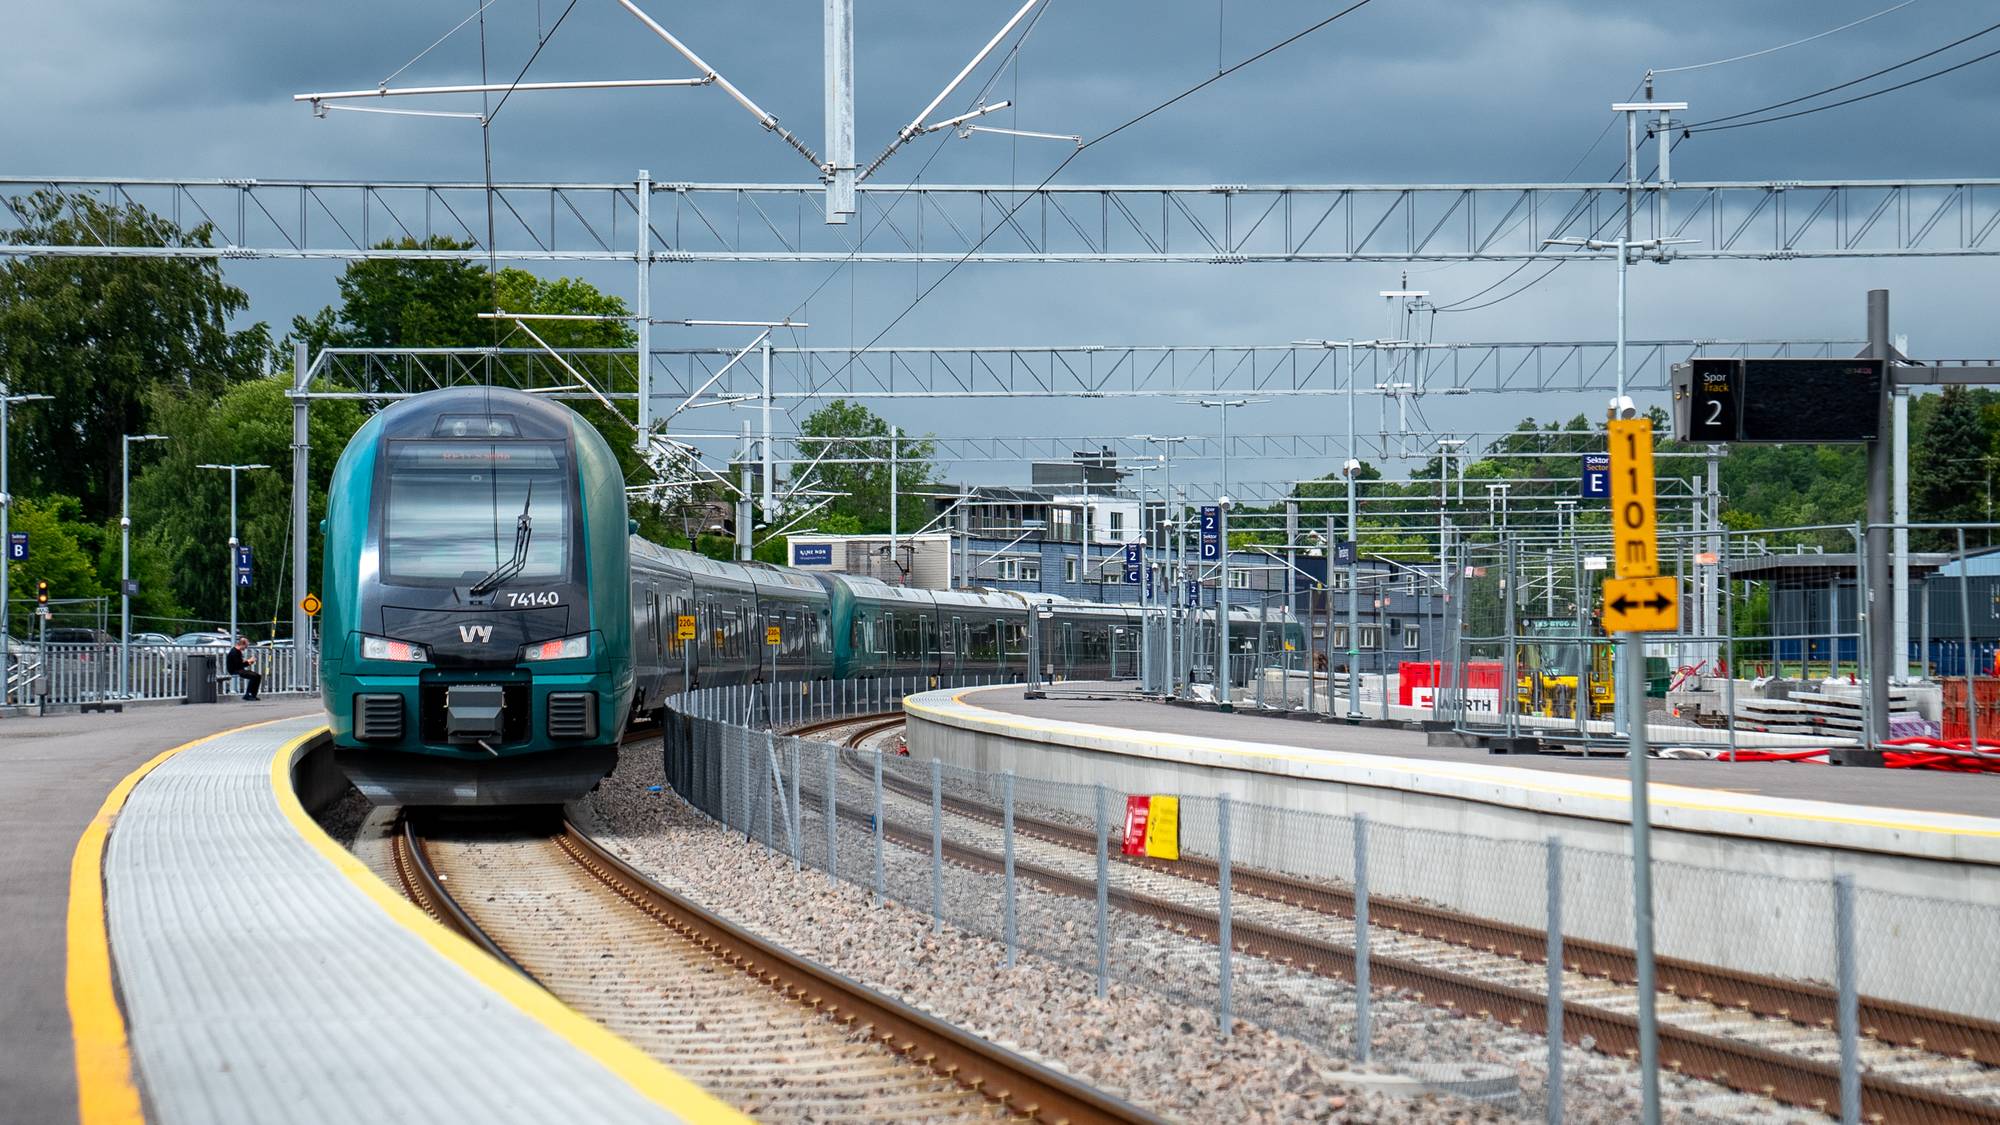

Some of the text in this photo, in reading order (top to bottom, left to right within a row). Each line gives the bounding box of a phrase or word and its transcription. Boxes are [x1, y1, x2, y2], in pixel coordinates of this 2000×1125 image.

[1703, 372, 1727, 383] Spor
[1703, 383, 1729, 392] Track
[1705, 400, 1722, 425] 2
[1586, 456, 1609, 464] Sektor
[1591, 473, 1604, 492] E
[1205, 517, 1214, 529] 2
[14, 544, 24, 557] B
[1129, 551, 1137, 561] 2
[1205, 544, 1215, 557] D
[241, 554, 247, 564] 1
[240, 575, 249, 585] A
[1130, 571, 1137, 581] C
[507, 591, 559, 607] 74140
